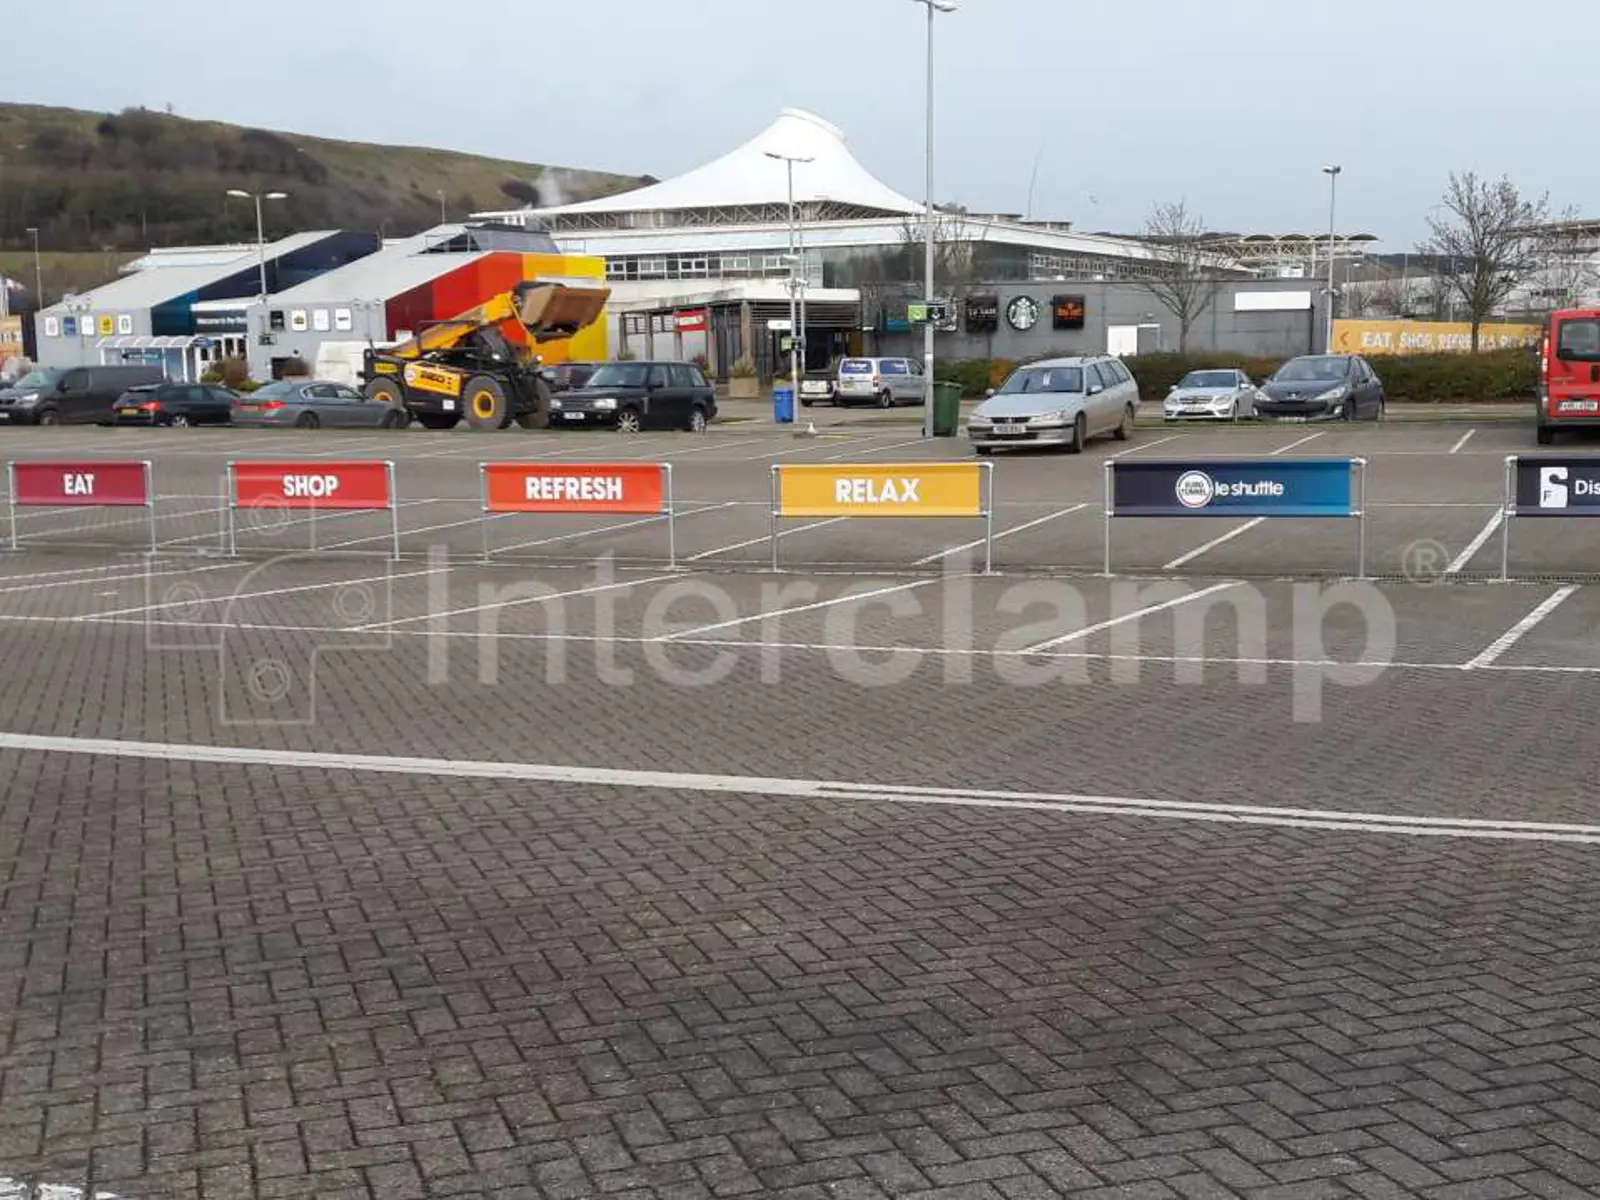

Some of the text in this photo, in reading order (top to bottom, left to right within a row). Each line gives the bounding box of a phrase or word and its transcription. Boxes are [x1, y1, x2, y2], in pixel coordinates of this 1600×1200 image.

[63, 474, 94, 494] EAT
[283, 475, 339, 496] SHOP
[525, 476, 623, 500] REFRESH
[835, 478, 920, 503] RELAX
[1214, 480, 1284, 496] le shuttle
